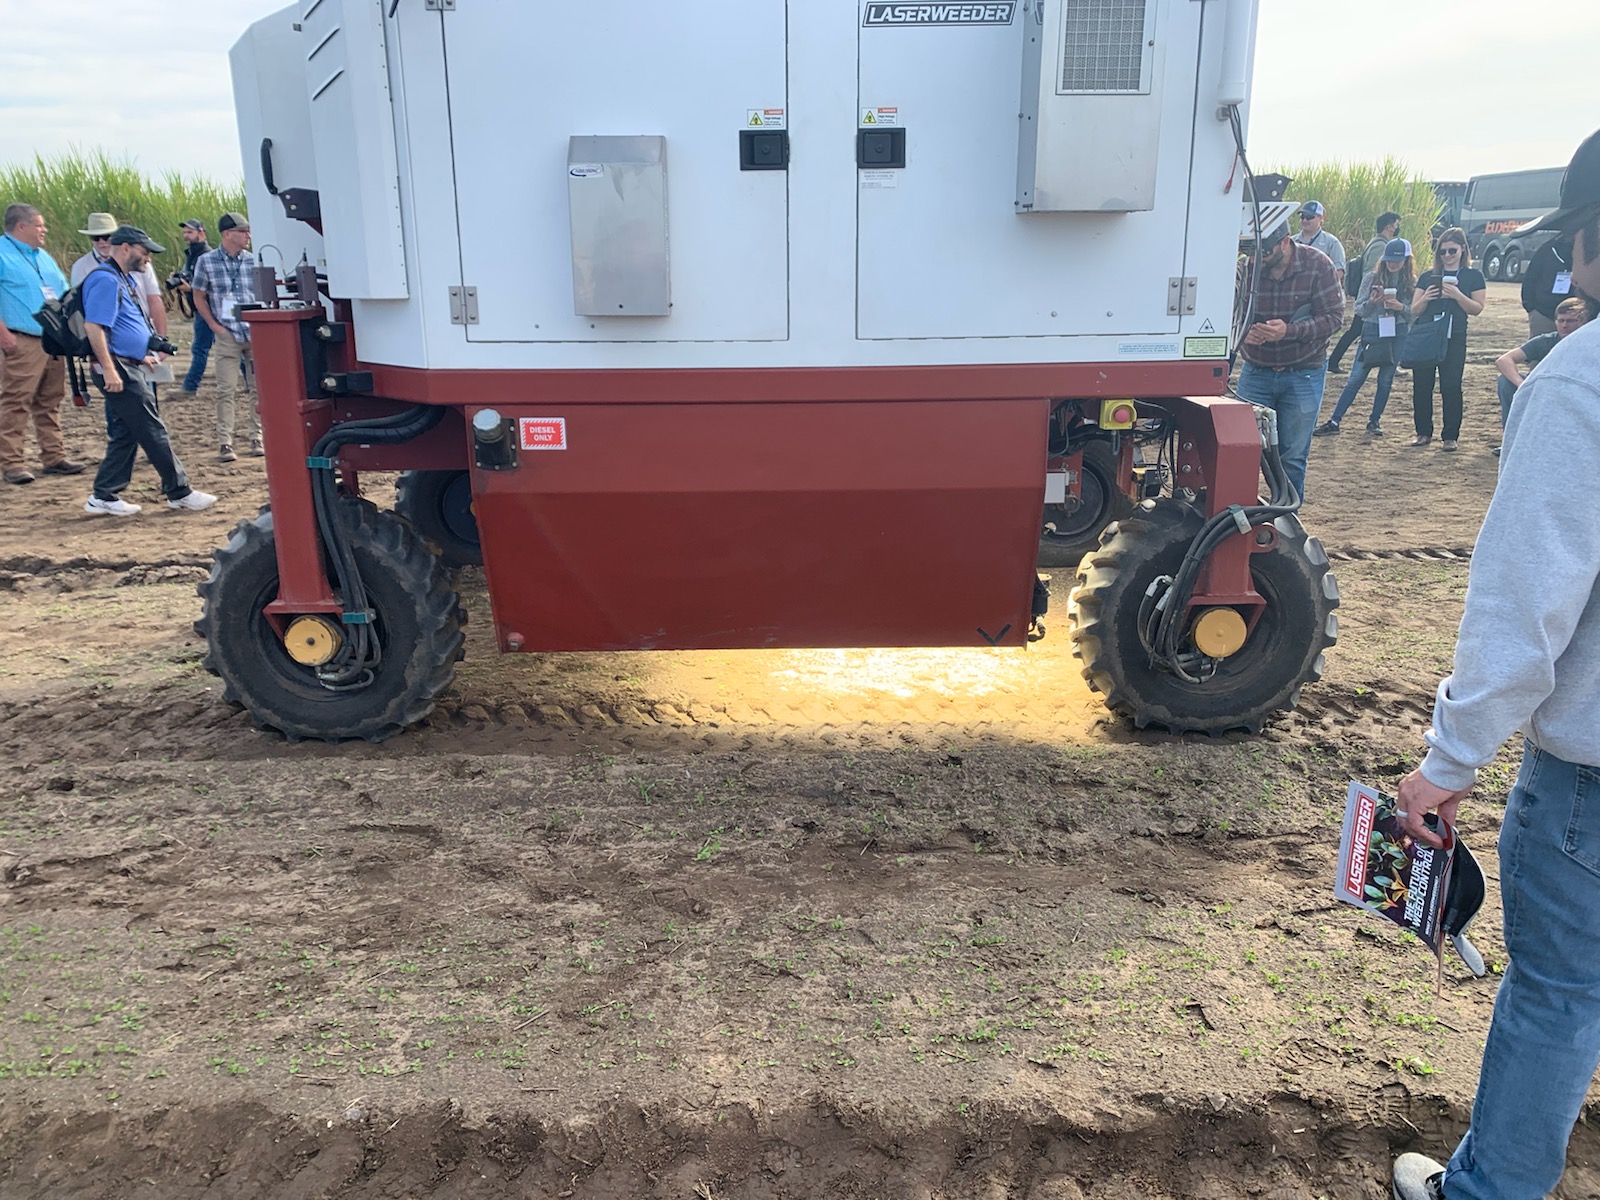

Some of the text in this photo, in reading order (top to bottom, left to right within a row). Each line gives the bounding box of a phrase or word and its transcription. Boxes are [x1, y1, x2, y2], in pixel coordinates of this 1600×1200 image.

[869, 5, 1010, 22] LASERWEEDER
[533, 434, 553, 442] ONLY
[1348, 798, 1374, 896] LASERWEEDER
[1408, 858, 1423, 901] FUTURE
[1412, 850, 1434, 927] WEED CONTROL
[1404, 900, 1415, 922] THE
